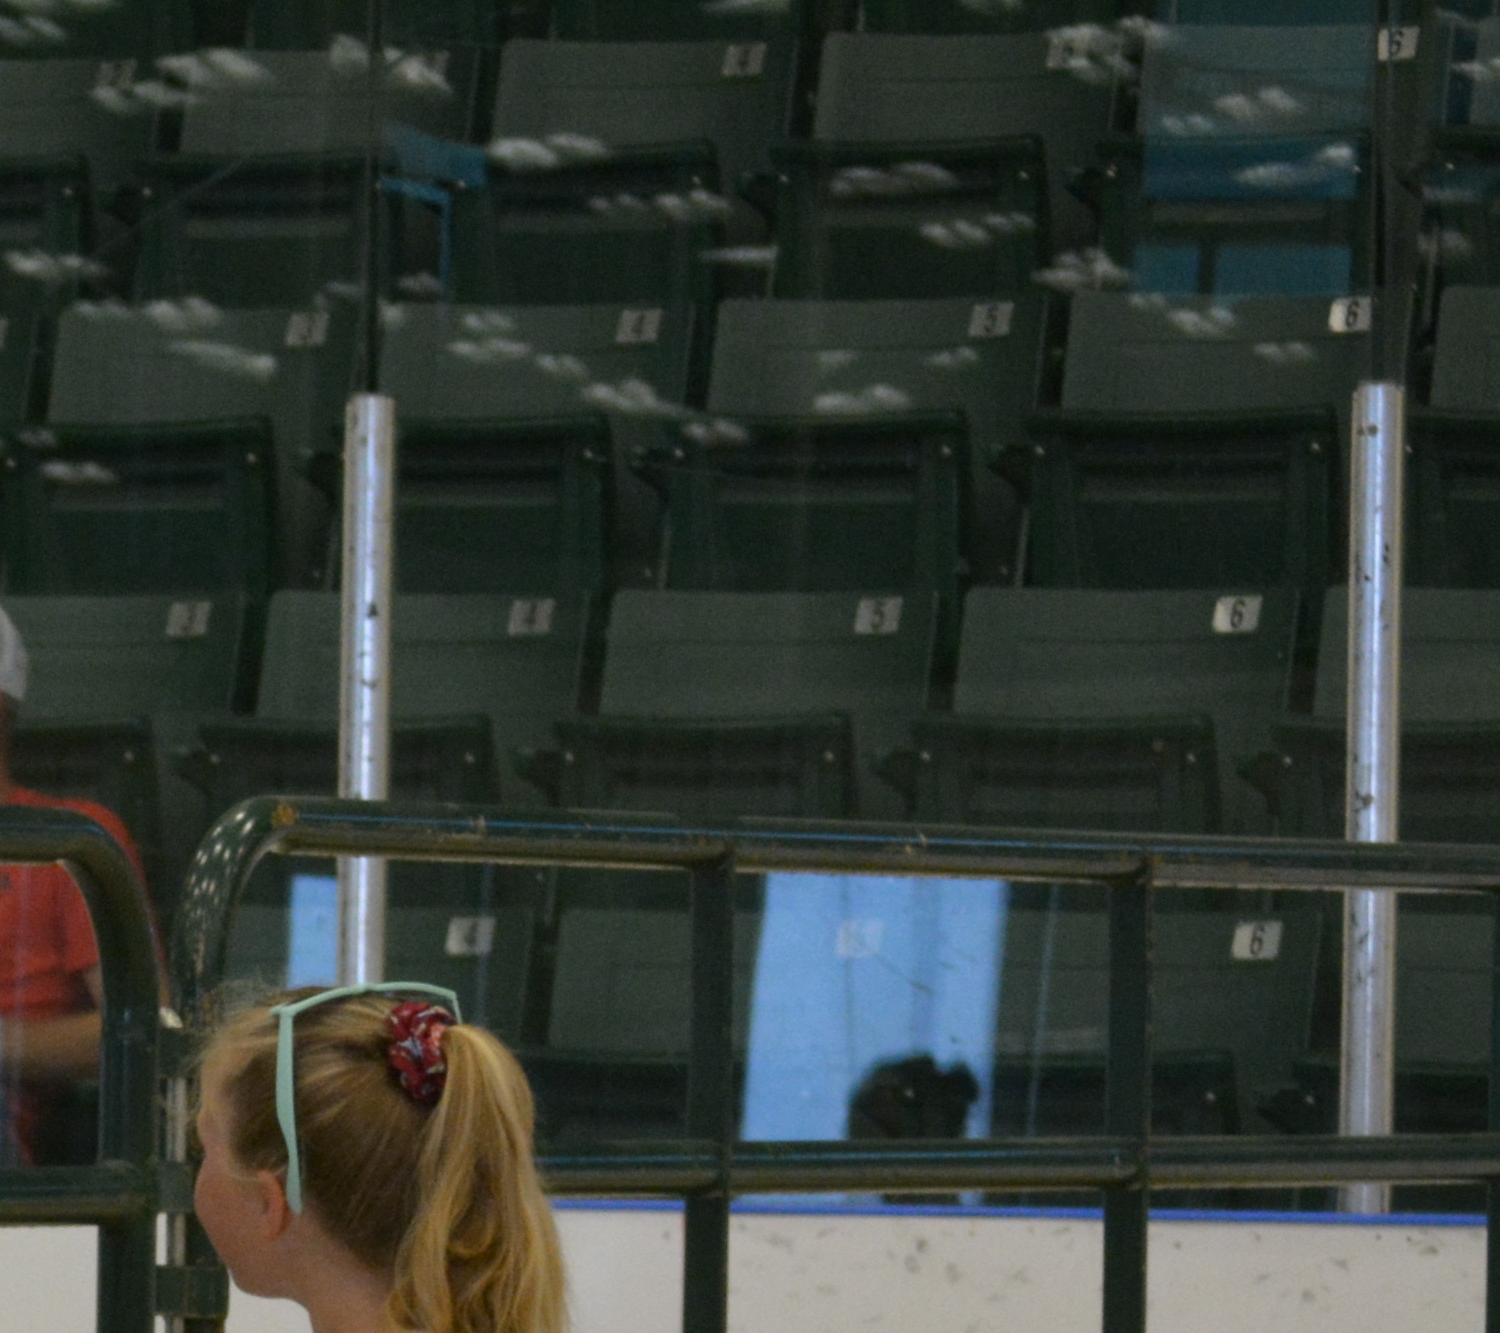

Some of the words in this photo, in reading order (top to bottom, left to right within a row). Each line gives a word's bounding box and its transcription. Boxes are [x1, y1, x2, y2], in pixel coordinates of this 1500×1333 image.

[1389, 29, 1404, 57] 6
[632, 312, 646, 338] 4
[984, 304, 999, 333] 5
[1345, 300, 1359, 329] 6
[522, 602, 538, 629] 4
[871, 600, 885, 629] 5
[1230, 599, 1245, 629] 6
[1250, 925, 1265, 955] 6
